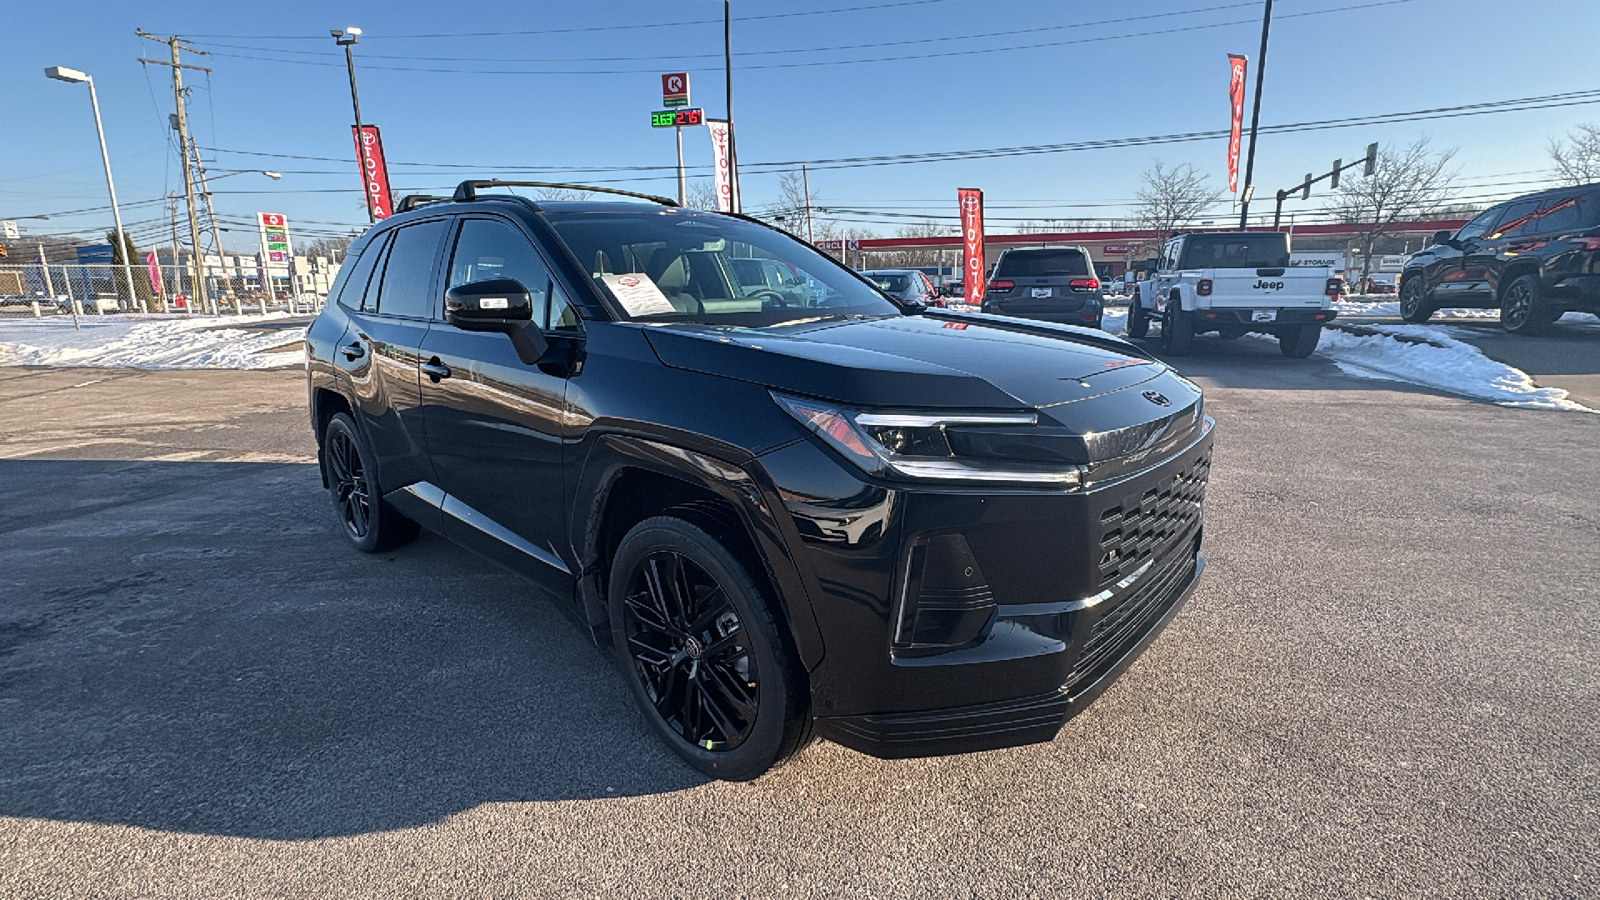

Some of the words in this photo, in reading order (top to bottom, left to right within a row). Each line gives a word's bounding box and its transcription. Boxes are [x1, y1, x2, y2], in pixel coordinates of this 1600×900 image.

[669, 78, 681, 92] K
[1229, 84, 1241, 185] YOTA
[364, 146, 386, 216] TOYOTA
[718, 144, 731, 213] TOYOT
[816, 241, 846, 250] CIRCL
[967, 214, 981, 299] TOYOTA
[1252, 279, 1284, 291] Jeep
